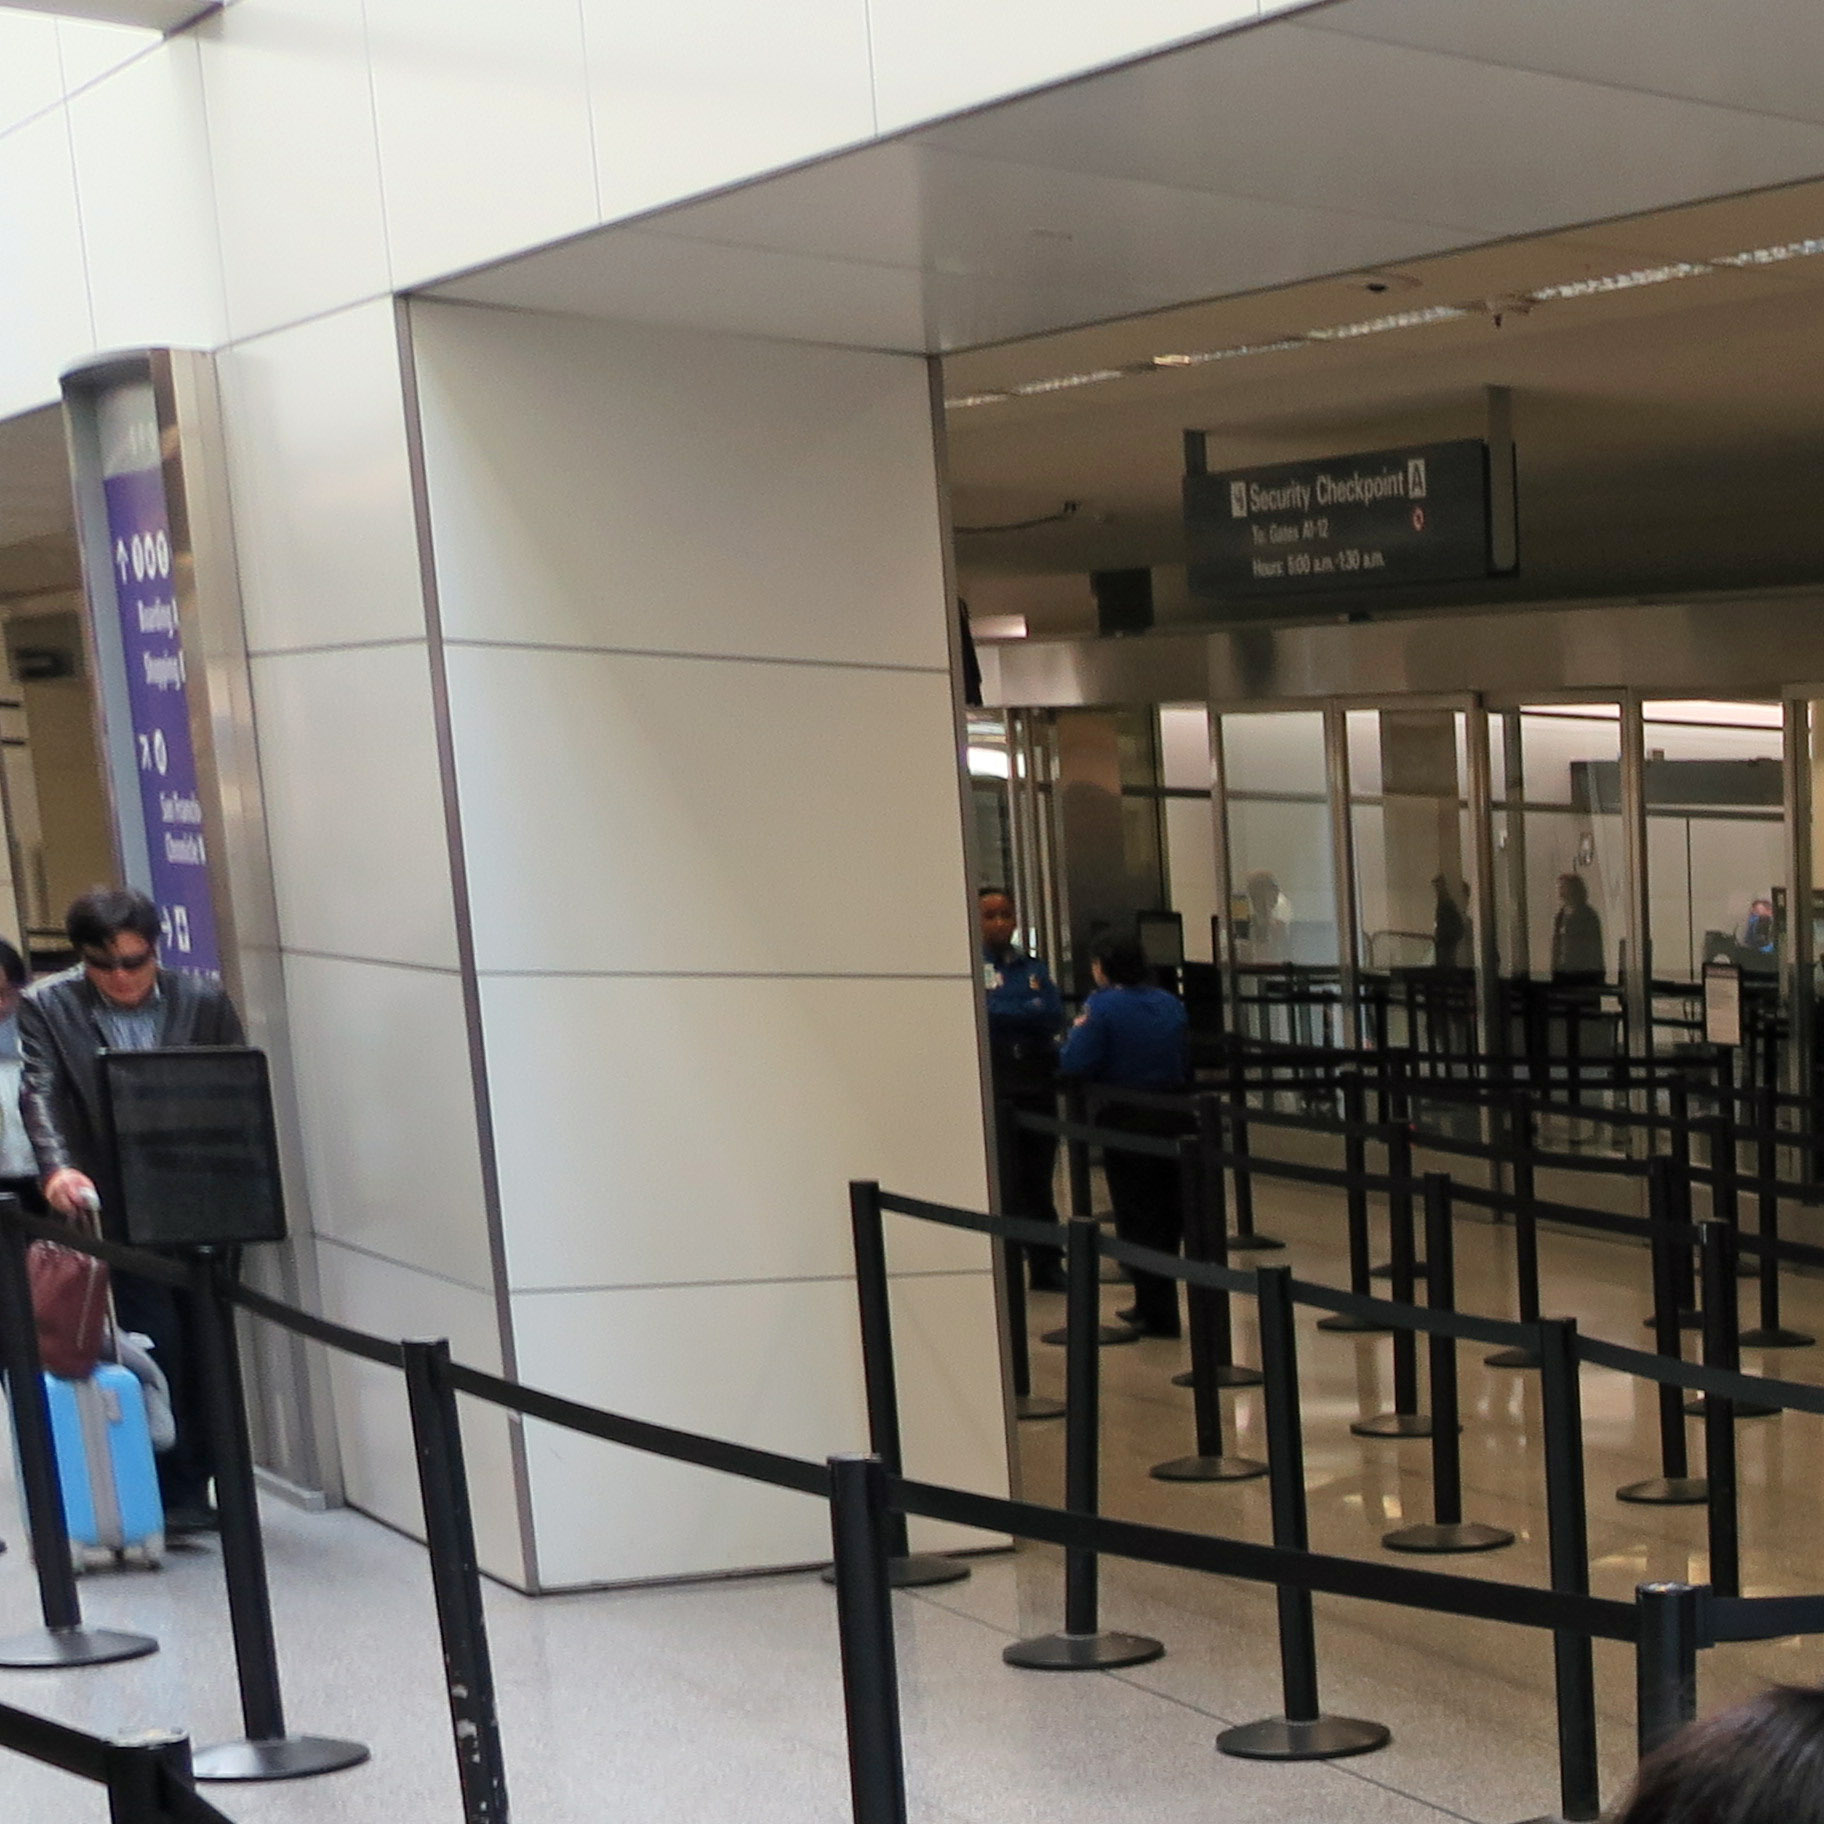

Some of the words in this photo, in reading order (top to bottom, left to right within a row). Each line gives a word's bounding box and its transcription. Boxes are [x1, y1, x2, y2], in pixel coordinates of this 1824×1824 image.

[1250, 480, 1312, 512] Security
[1316, 466, 1404, 507] Checkpoint
[1269, 524, 1300, 544] Gates
